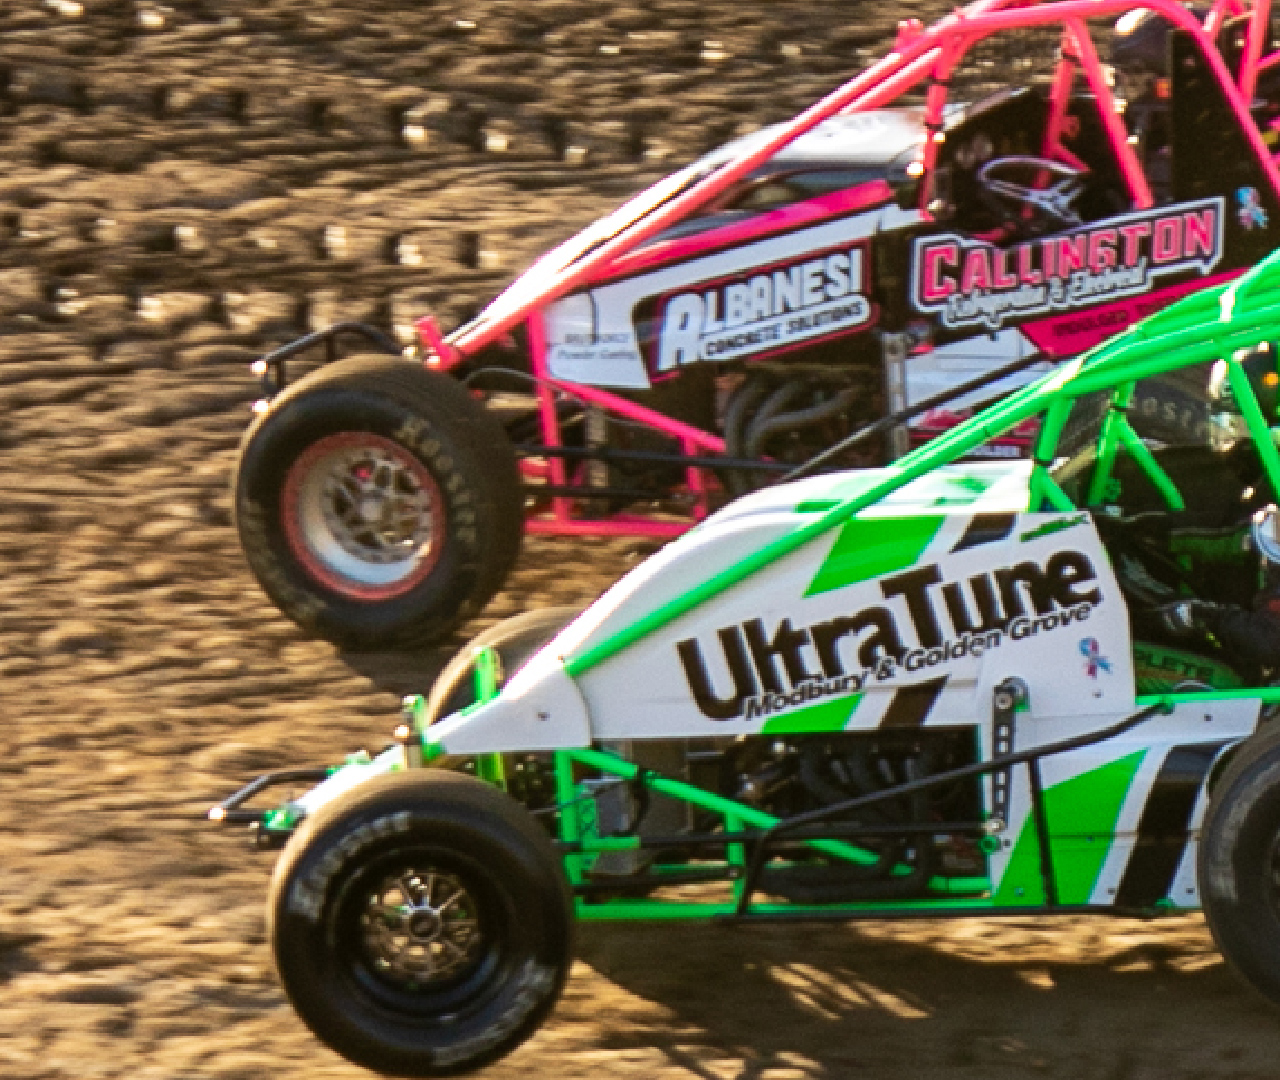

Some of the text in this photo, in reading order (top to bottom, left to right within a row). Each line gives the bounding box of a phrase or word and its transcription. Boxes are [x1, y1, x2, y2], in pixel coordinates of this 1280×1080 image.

[922, 207, 1216, 303] CALLINGTON
[656, 246, 863, 373] ALBANESI
[705, 302, 863, 359] CONCRETE SOLUTIONS
[745, 604, 1093, 721] Modbury & Golden Grove
